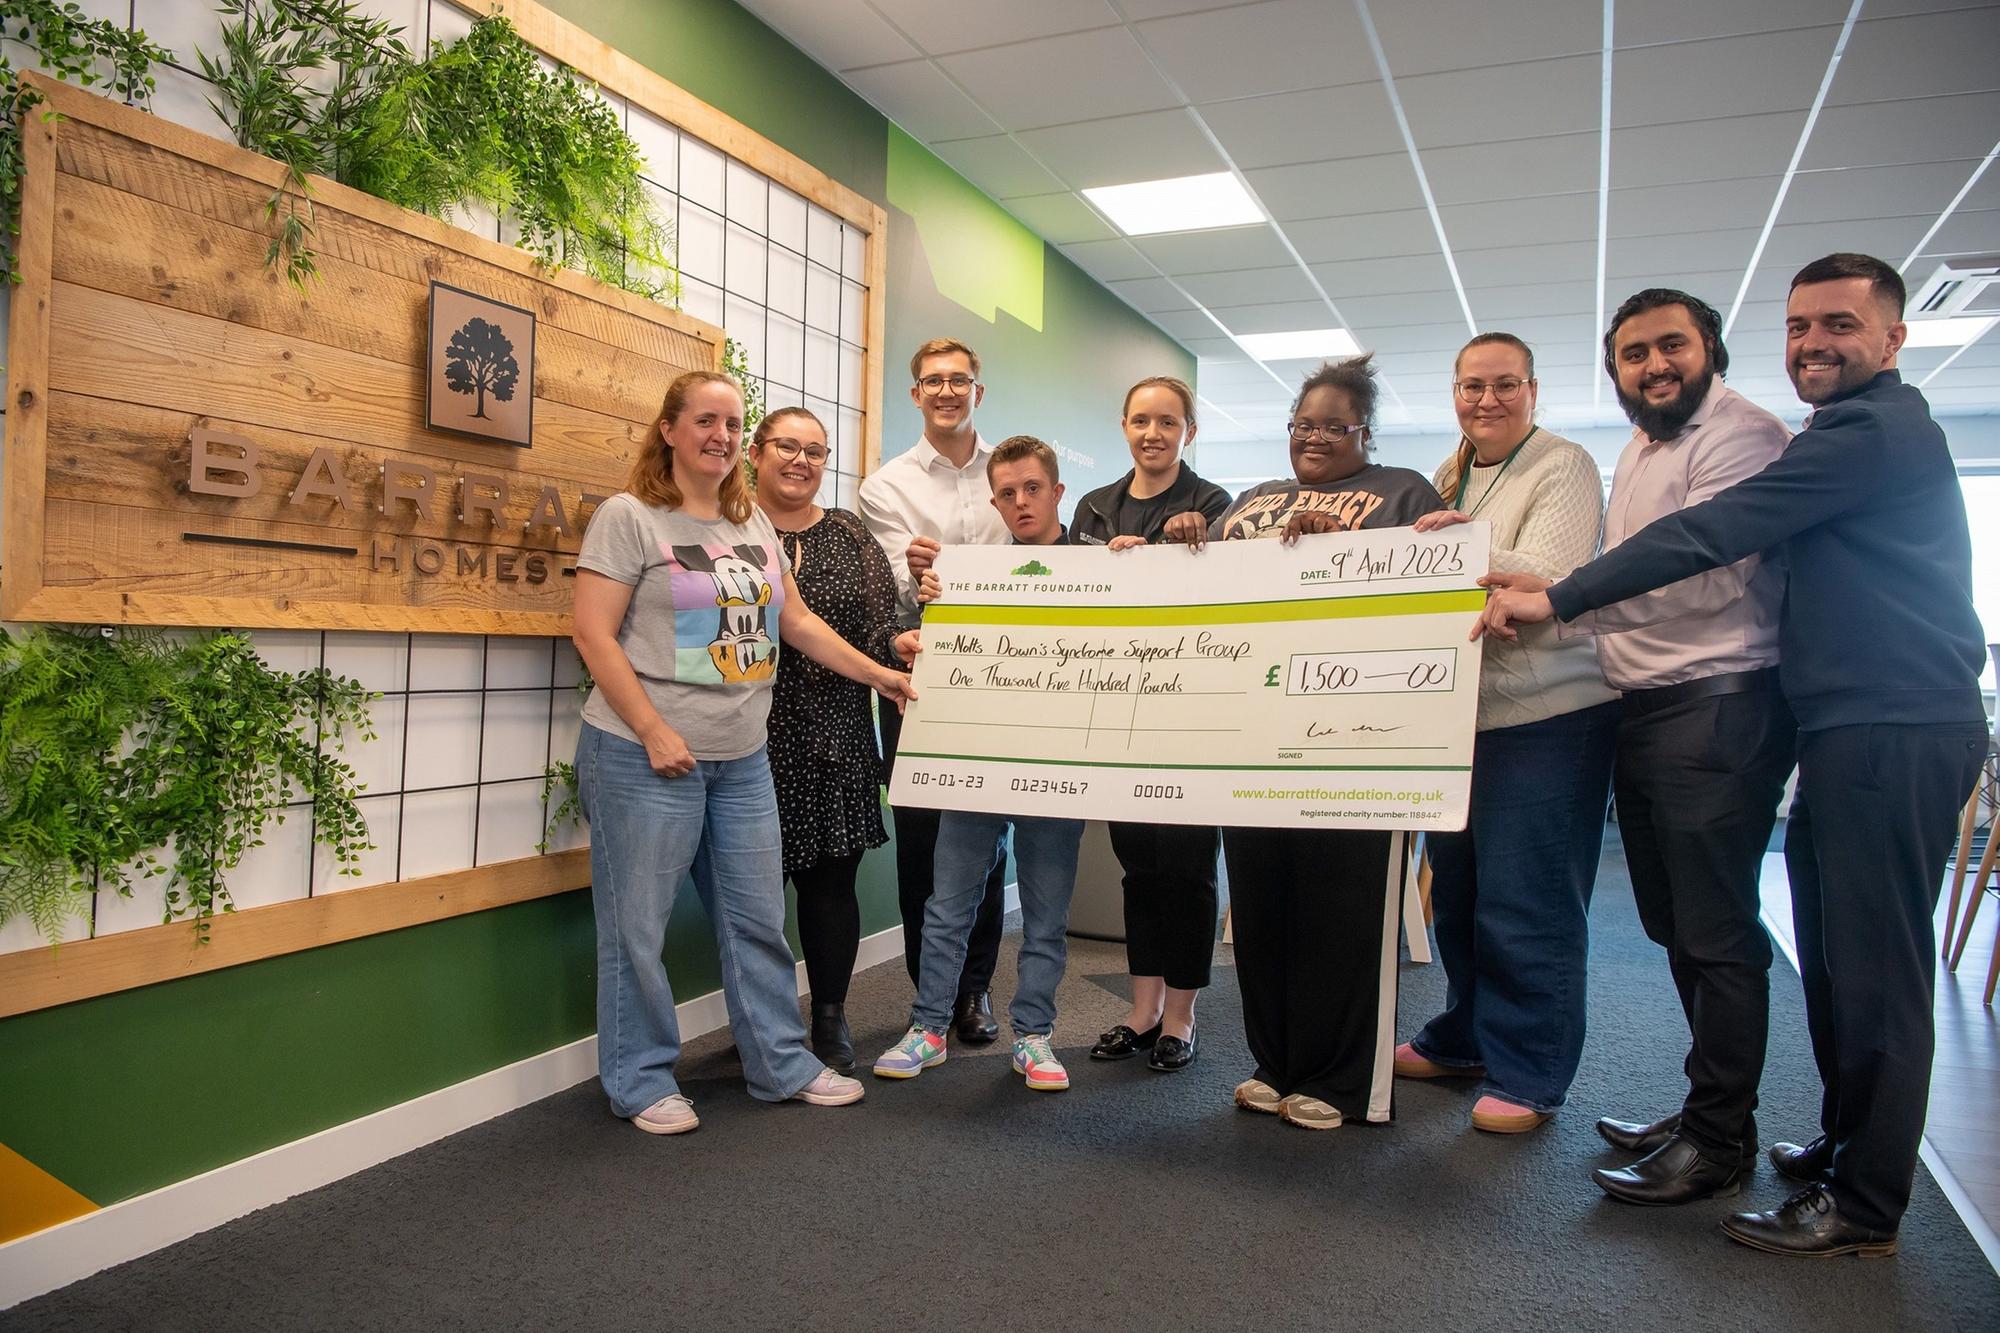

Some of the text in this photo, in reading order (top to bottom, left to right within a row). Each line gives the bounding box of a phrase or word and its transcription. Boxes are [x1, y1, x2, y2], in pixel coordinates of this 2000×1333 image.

[1286, 490, 1384, 532] ENERGY
[371, 538, 549, 584] HOMES
[1300, 570, 1331, 580] DATE:
[1356, 547, 1394, 583] April
[1400, 542, 1469, 576] 2025
[949, 582, 1112, 593] THE BARRATT FOUNDATION
[934, 630, 1251, 667] PAY: Notts Down's Syndrome Support Group
[949, 661, 1183, 695] One Thousand Five Hundred Pounds
[1263, 664, 1282, 687] £
[1277, 752, 1303, 760] SIGNED
[911, 771, 1184, 800] 00-01-23 01234567 00001
[1231, 787, 1444, 805] www.barrattfoundation.org.uk
[1299, 809, 1342, 819] Registered
[1342, 809, 1372, 820] charity
[1373, 810, 1408, 820] number:
